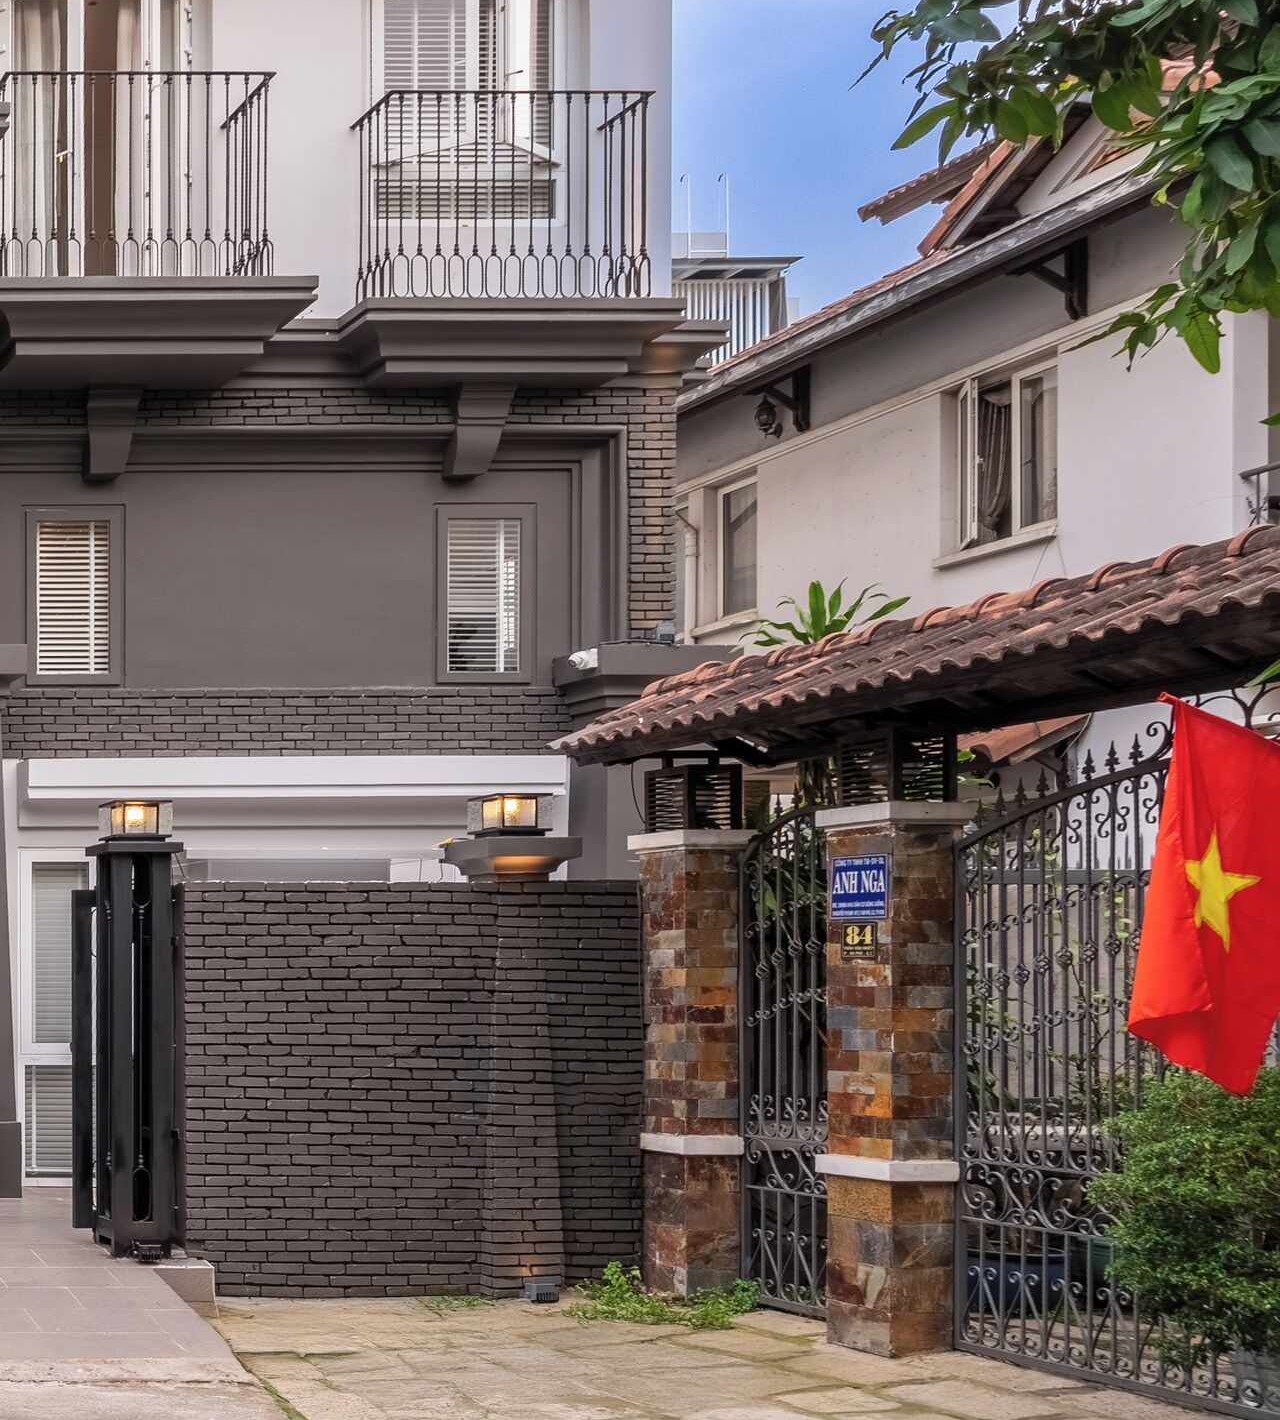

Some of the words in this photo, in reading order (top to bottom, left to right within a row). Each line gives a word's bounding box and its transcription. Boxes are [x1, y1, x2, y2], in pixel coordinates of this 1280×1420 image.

[833, 871, 858, 894] ANH
[860, 870, 885, 893] NGA
[845, 925, 873, 945] 84
